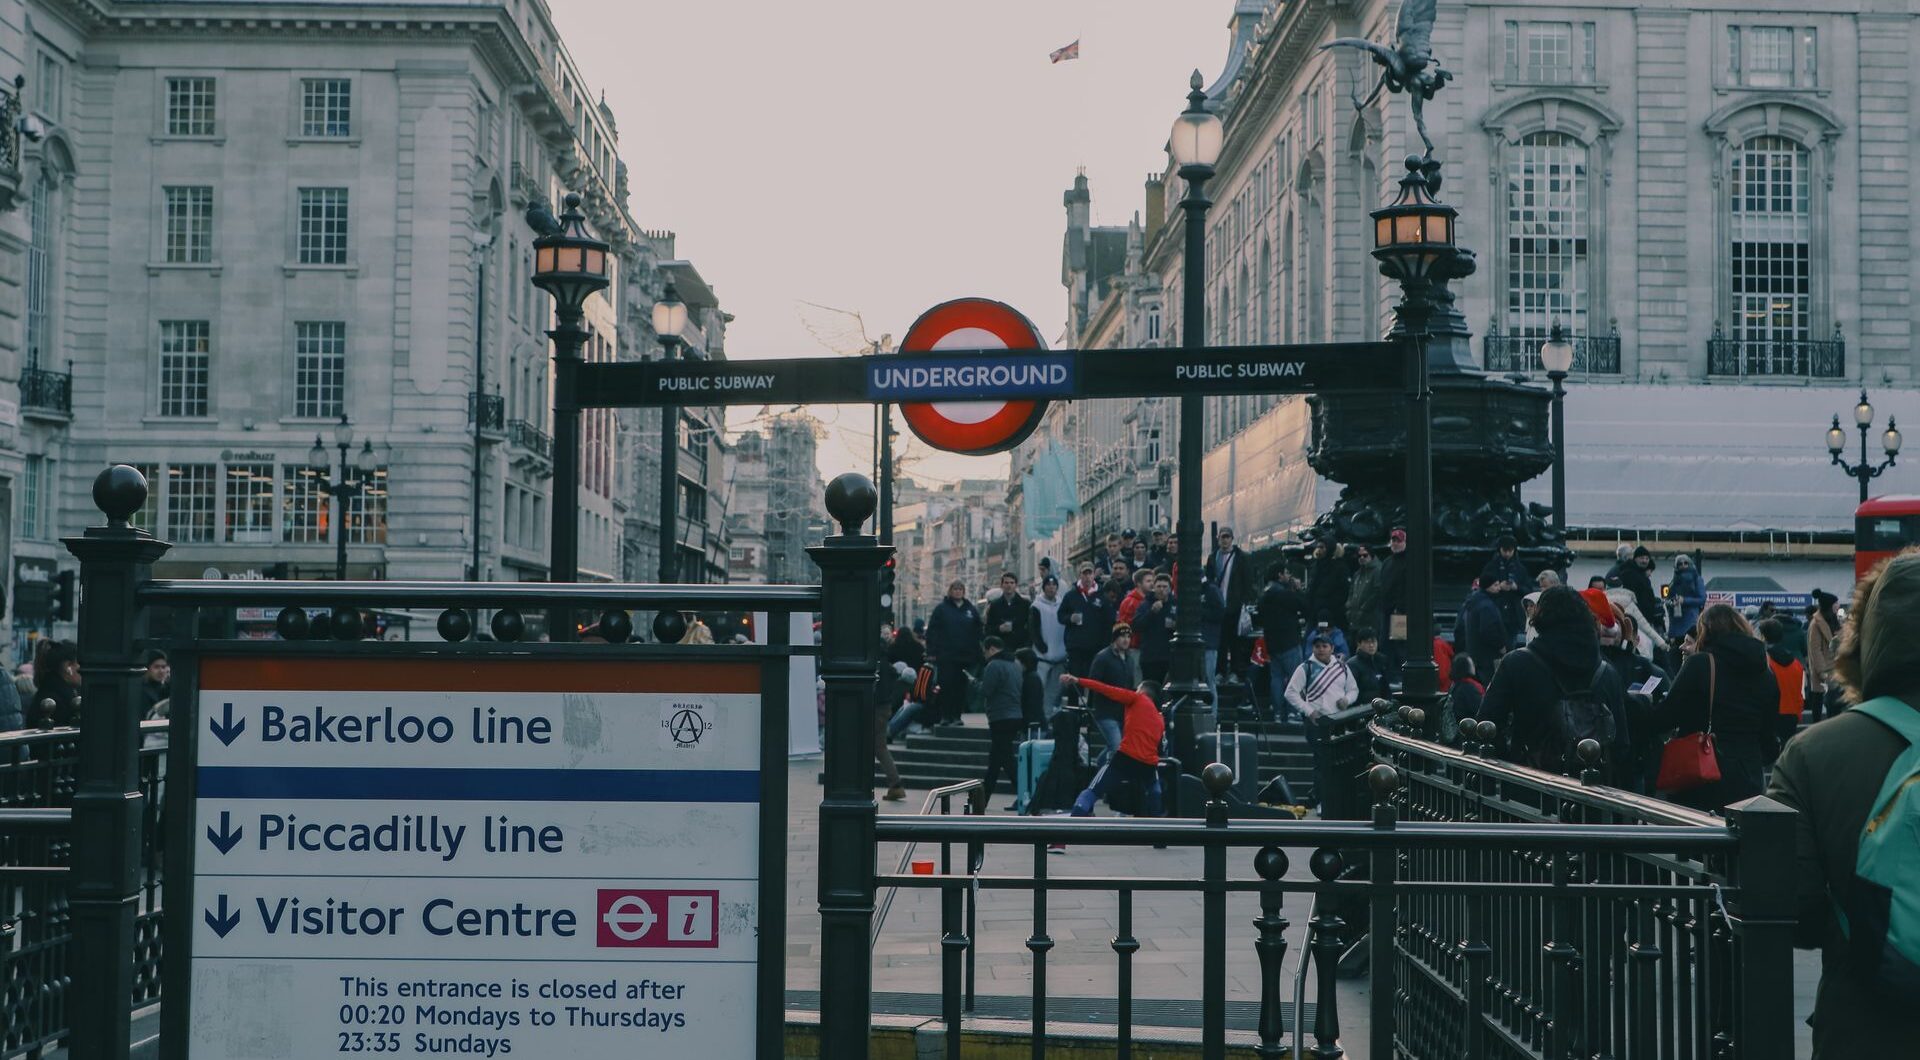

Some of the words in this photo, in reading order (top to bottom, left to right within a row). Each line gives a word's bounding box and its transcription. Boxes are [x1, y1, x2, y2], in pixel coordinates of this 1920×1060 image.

[658, 376, 710, 391] PUBLIC
[714, 374, 775, 390] SUBWAY
[874, 363, 1067, 391] UNDERGROUND
[1176, 363, 1233, 379] PUBLIC
[1237, 361, 1306, 378] SUBWAY
[234, 450, 275, 461] realbuzz
[261, 705, 454, 744] Bakerloo
[472, 706, 552, 745] line
[661, 720, 670, 728] 13
[704, 722, 712, 730] 12
[259, 813, 467, 862] Piccadilly
[484, 815, 564, 854] line
[255, 896, 405, 936] Visitor
[422, 898, 577, 937] Centre
[339, 976, 389, 998] This
[397, 979, 502, 999] entrance
[511, 977, 530, 999] is
[538, 978, 617, 1000] closed
[625, 979, 686, 1001] after
[339, 1004, 406, 1026] 00:20
[415, 1005, 521, 1031] Mondays
[529, 1008, 556, 1028] to
[564, 1006, 686, 1032] Thursdays
[338, 1031, 401, 1054] 23:35
[414, 1032, 512, 1058] Sundays
